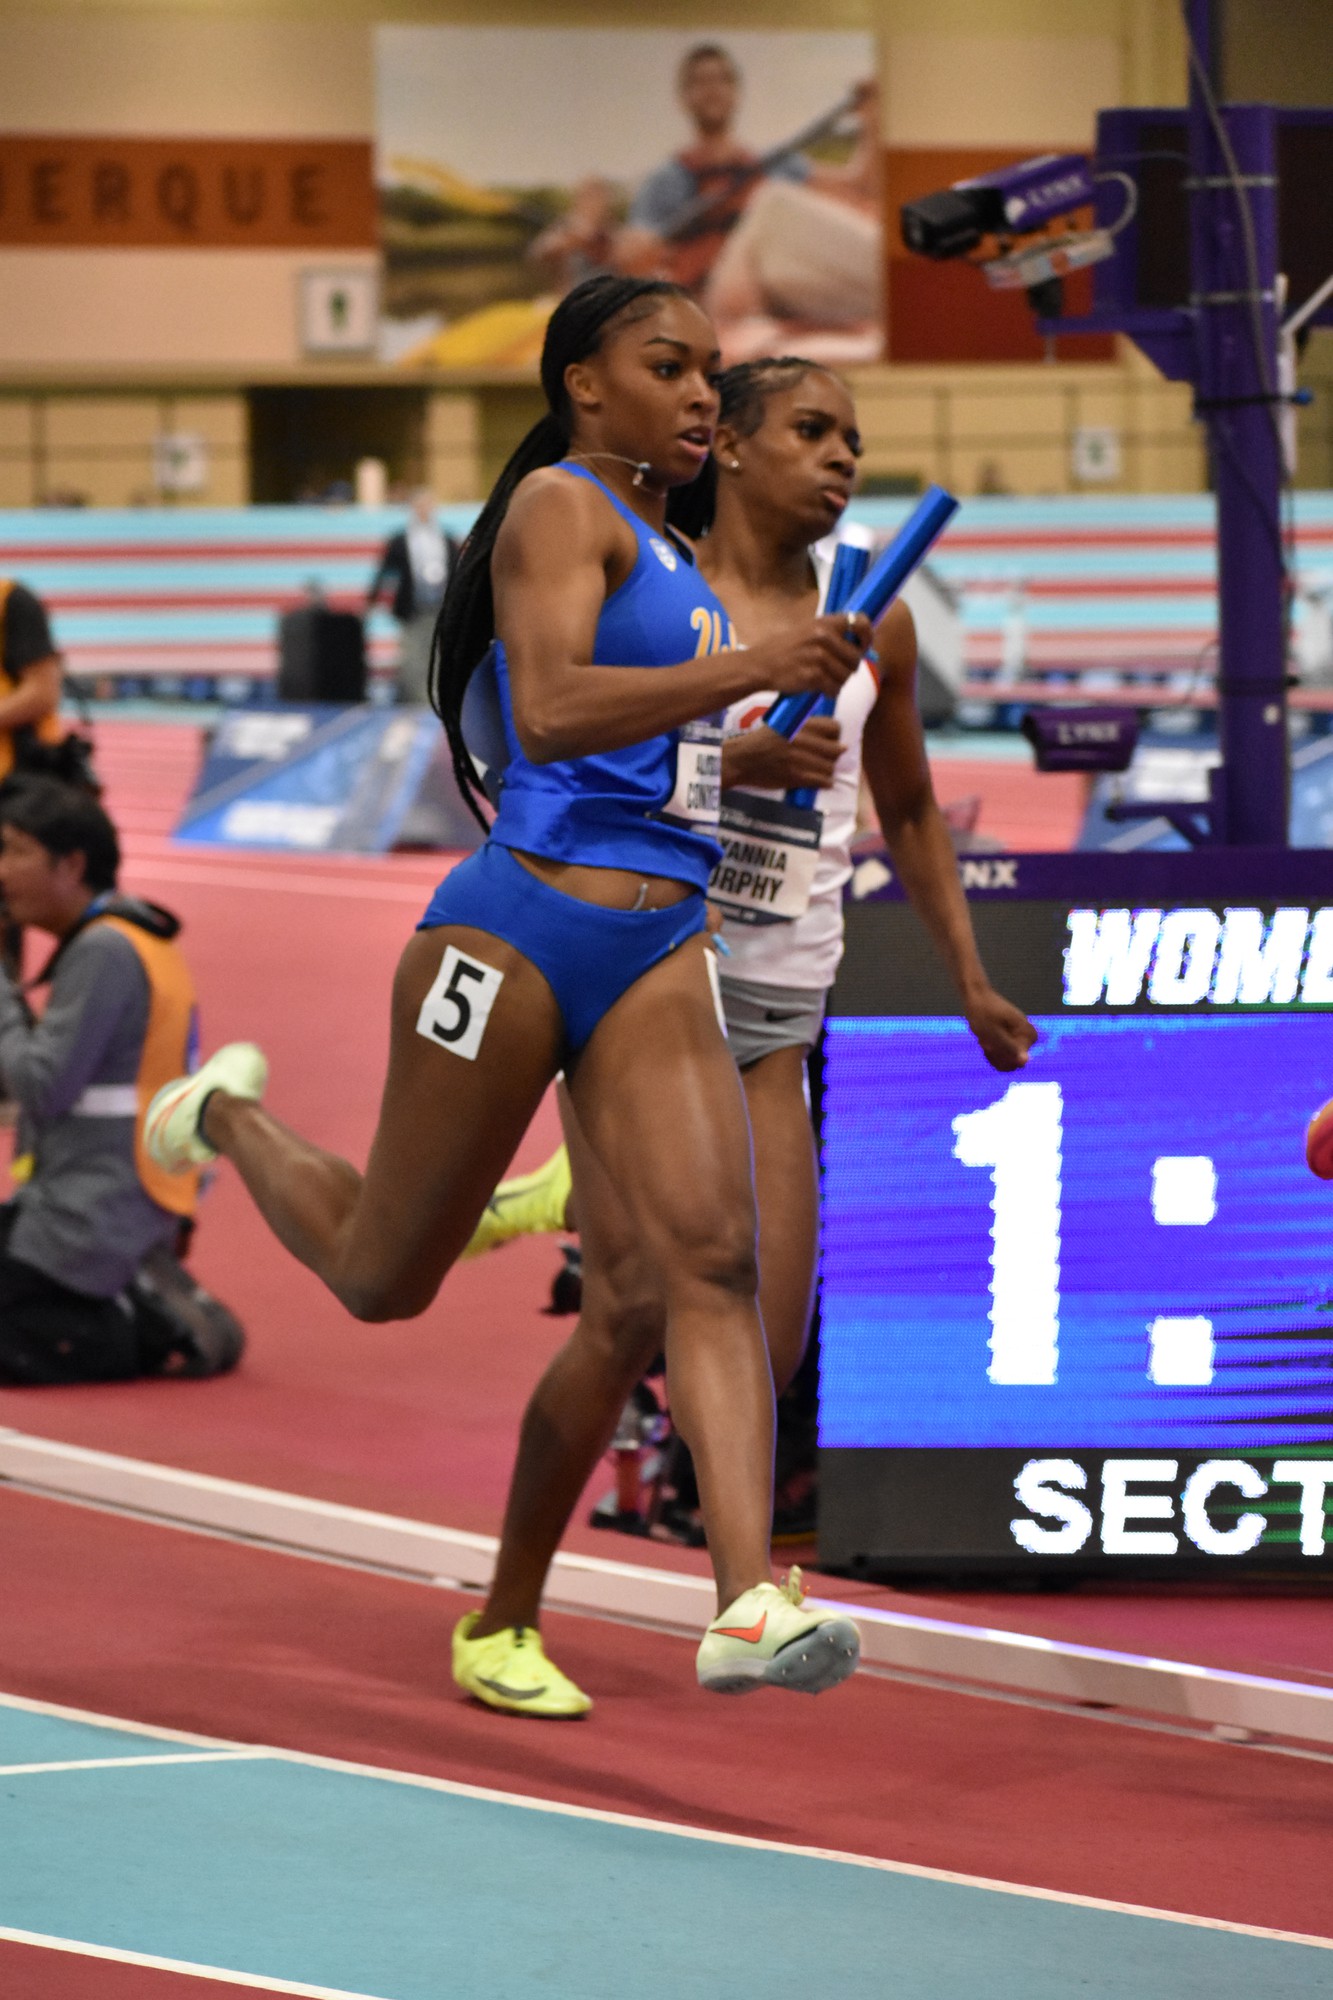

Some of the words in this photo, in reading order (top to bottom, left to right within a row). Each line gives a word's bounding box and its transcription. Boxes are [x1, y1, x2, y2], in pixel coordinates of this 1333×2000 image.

[0, 160, 329, 234] ERQUE
[1057, 721, 1120, 746] LYNX
[960, 859, 1018, 889] NX
[433, 959, 486, 1042] 5
[1010, 1458, 1333, 1556] SECT
